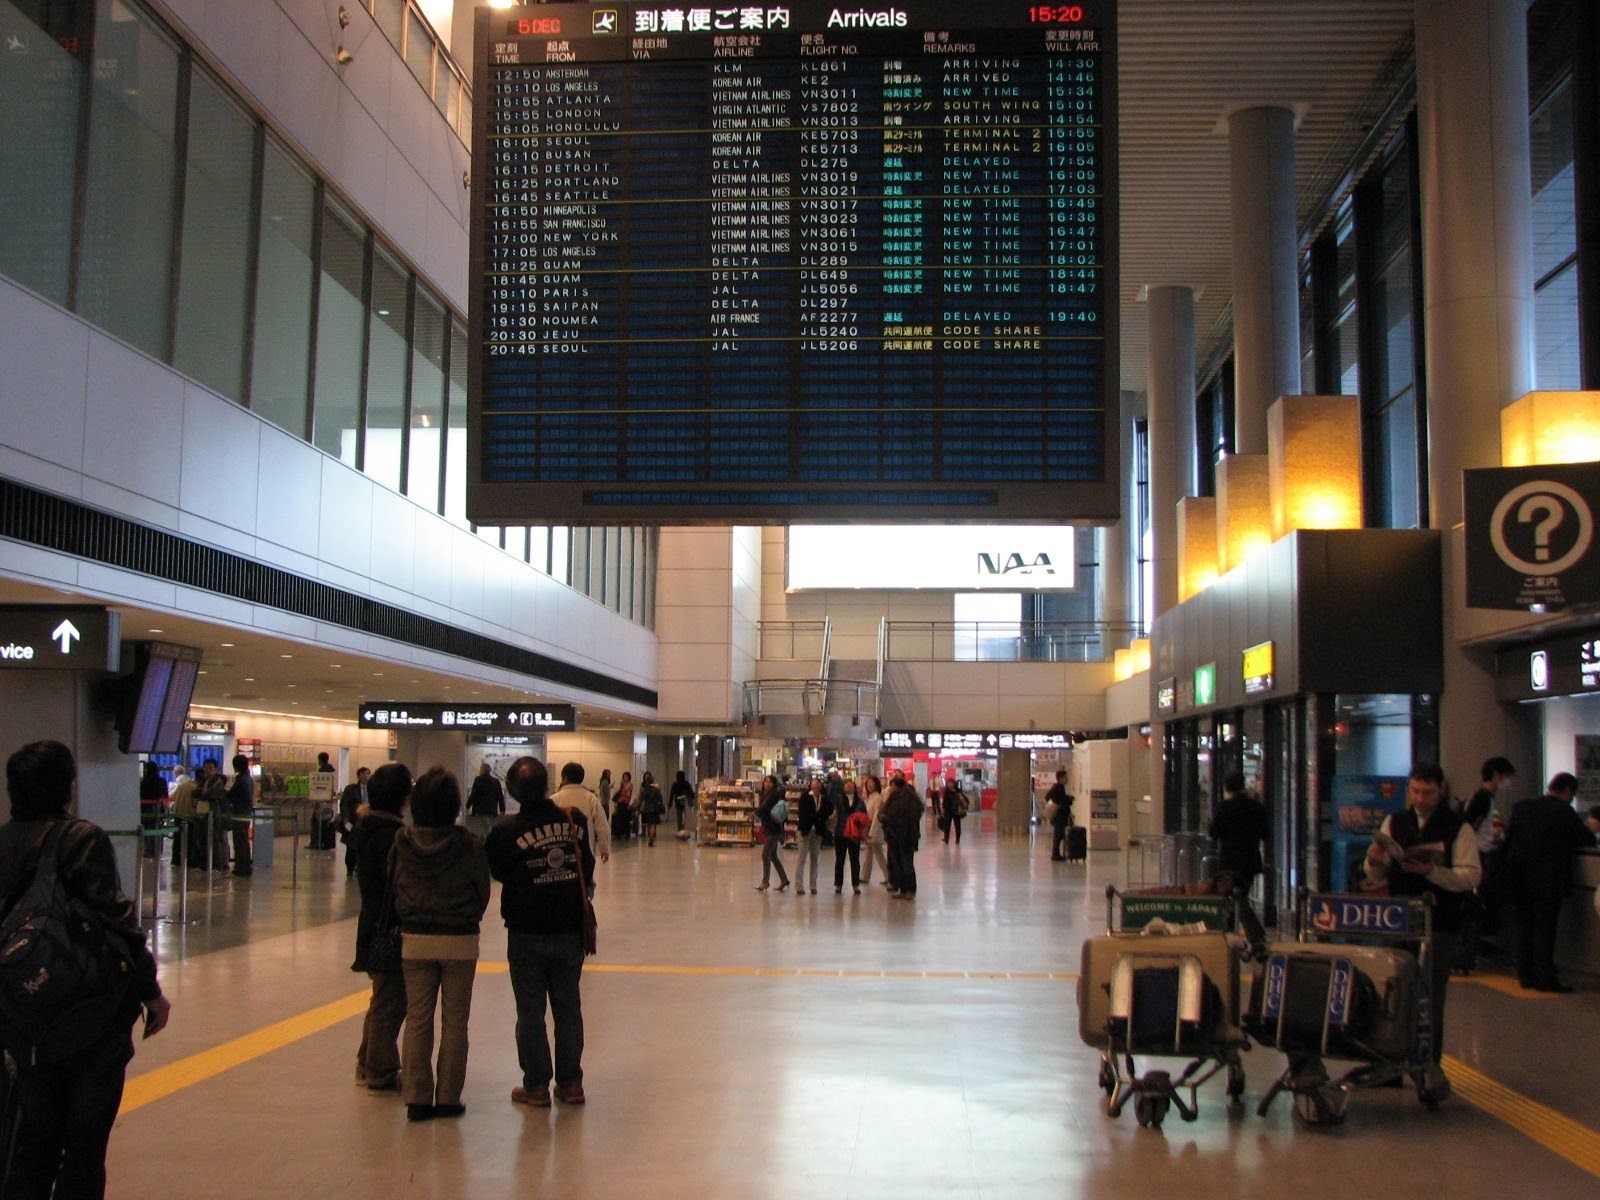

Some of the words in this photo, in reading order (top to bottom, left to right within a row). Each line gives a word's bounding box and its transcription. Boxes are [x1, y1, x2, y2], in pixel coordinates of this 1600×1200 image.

[827, 8, 907, 27] Arrivals
[1029, 6, 1083, 22] 15:20
[635, 7, 790, 32] 到着便ご案内
[532, 18, 560, 33] DEC
[714, 35, 761, 46] 航空会社
[800, 46, 837, 55] FLIGHT
[842, 45, 859, 55] NO.
[924, 44, 976, 53] REMARKS
[1046, 42, 1071, 51] WILL
[546, 52, 576, 62] FROM
[633, 50, 650, 59] VIA
[714, 48, 754, 57] AIRLINE
[495, 54, 520, 63] TIME
[714, 64, 742, 72] KLM
[802, 62, 846, 71] KL861
[943, 60, 1019, 68] ARRIVING
[1049, 60, 1094, 68] 14:30
[498, 70, 540, 80] 12:50
[546, 70, 589, 78] AMSTERDAM
[943, 74, 1010, 82] ARRIVED
[1049, 73, 1094, 82] 14:46
[712, 78, 742, 87] KOREAN
[746, 78, 762, 87] AIR
[801, 76, 828, 85] KE2
[497, 84, 540, 93] 15:10
[545, 83, 560, 92] LOS
[564, 83, 598, 92] ANGELES
[943, 88, 972, 96] NEW
[984, 88, 1018, 96] TIME
[1049, 87, 1093, 96] 15:34
[712, 91, 748, 100] VIETNAM
[751, 91, 790, 100] AIRLINES
[802, 90, 856, 98] VN3011
[497, 98, 540, 107] 15:55
[546, 96, 610, 104] ATLANTA
[712, 105, 742, 114] VIRGIN
[746, 105, 786, 114] ATLANTIC
[801, 103, 858, 112] VS7802
[944, 102, 990, 110] SOUTH
[1002, 102, 1039, 110] WING
[1049, 101, 1092, 110] 15:01
[497, 111, 539, 120] 15:55
[546, 110, 600, 118] LONDON
[802, 117, 858, 126] VN3013
[1050, 115, 1093, 124] 14:54
[496, 125, 539, 134] 16:05
[944, 130, 1020, 138] TERMINAL
[1032, 130, 1040, 138] 2
[1049, 129, 1094, 138] 15:55
[801, 131, 858, 140] KE5703
[496, 138, 539, 148] 16:05
[546, 137, 590, 146] SEOUL
[801, 144, 858, 154] KE5713
[1049, 143, 1094, 152] 16:05
[496, 152, 539, 161] 16:10
[546, 151, 590, 159] BUSAN
[713, 160, 760, 169] DELTA
[801, 158, 848, 168] DL275
[943, 157, 1010, 166] DELAYED
[1049, 157, 1094, 166] 17:54
[496, 166, 538, 175] 16:15
[545, 164, 607, 173] DETROIT
[712, 174, 746, 183] VIETNAM
[750, 174, 790, 183] AIRLINES
[801, 172, 858, 182] VN3019
[1050, 171, 1094, 180] 16:09
[495, 179, 538, 188] 16:25
[545, 178, 619, 186] PORTLAND
[801, 186, 856, 196] VN3021
[1049, 185, 1095, 194] 17:03
[495, 193, 538, 202] 16:45
[546, 192, 608, 200] SEATTLE
[801, 200, 858, 210] VN3017
[1050, 199, 1094, 208] 16:49
[495, 206, 538, 216] 16:50
[544, 206, 596, 215] MINNEAPOLIS
[800, 214, 858, 224] VN3023
[1049, 213, 1095, 222] 16:38
[494, 220, 538, 230] 16:55
[543, 220, 558, 228] SAN
[562, 220, 606, 228] FRANCISCO
[800, 228, 856, 238] VN3061
[1050, 227, 1094, 236] 16:47
[494, 234, 538, 243] 17:00
[544, 233, 572, 241] NEW
[583, 233, 618, 241] YORK
[800, 242, 857, 252] VN3015
[1049, 241, 1093, 250] 17:01
[494, 248, 537, 257] 17:05
[543, 247, 558, 256] LOS
[562, 247, 596, 256] ANGELES
[800, 256, 848, 266] DL289
[1049, 256, 1095, 264] 18:02
[493, 262, 537, 271] 18:25
[544, 261, 580, 269] GUAM
[800, 270, 848, 280] DL649
[1050, 270, 1095, 278] 18:44
[493, 275, 536, 285] 18:45
[543, 275, 580, 283] GUAM
[712, 286, 738, 294] JAL
[801, 284, 858, 294] JL5056
[1050, 284, 1095, 293] 18:47
[493, 289, 537, 298] 19:10
[492, 303, 536, 312] 19:15
[544, 302, 598, 311] SAIPAN
[800, 298, 847, 308] DL297
[542, 316, 598, 324] NOUMEA
[710, 314, 726, 323] AIR
[730, 314, 760, 323] FRANCE
[800, 312, 857, 322] AF2277
[1050, 312, 1096, 321] 19:40
[492, 317, 536, 326] 19:30
[543, 330, 578, 339] JEJU
[800, 327, 858, 336] JL5240
[943, 326, 980, 334] CODE
[994, 326, 1040, 334] SHARE
[491, 331, 536, 340] 20:30
[490, 345, 536, 354] 20:45
[543, 344, 588, 353] SEOUL
[800, 341, 858, 350] JL5206
[978, 552, 1055, 574] NAA
[1126, 903, 1170, 912] WELCOME
[1187, 904, 1218, 914] JAPAN
[1342, 904, 1402, 928] DHC
[1267, 965, 1282, 1008] DHC
[1330, 970, 1347, 1014] DHC
